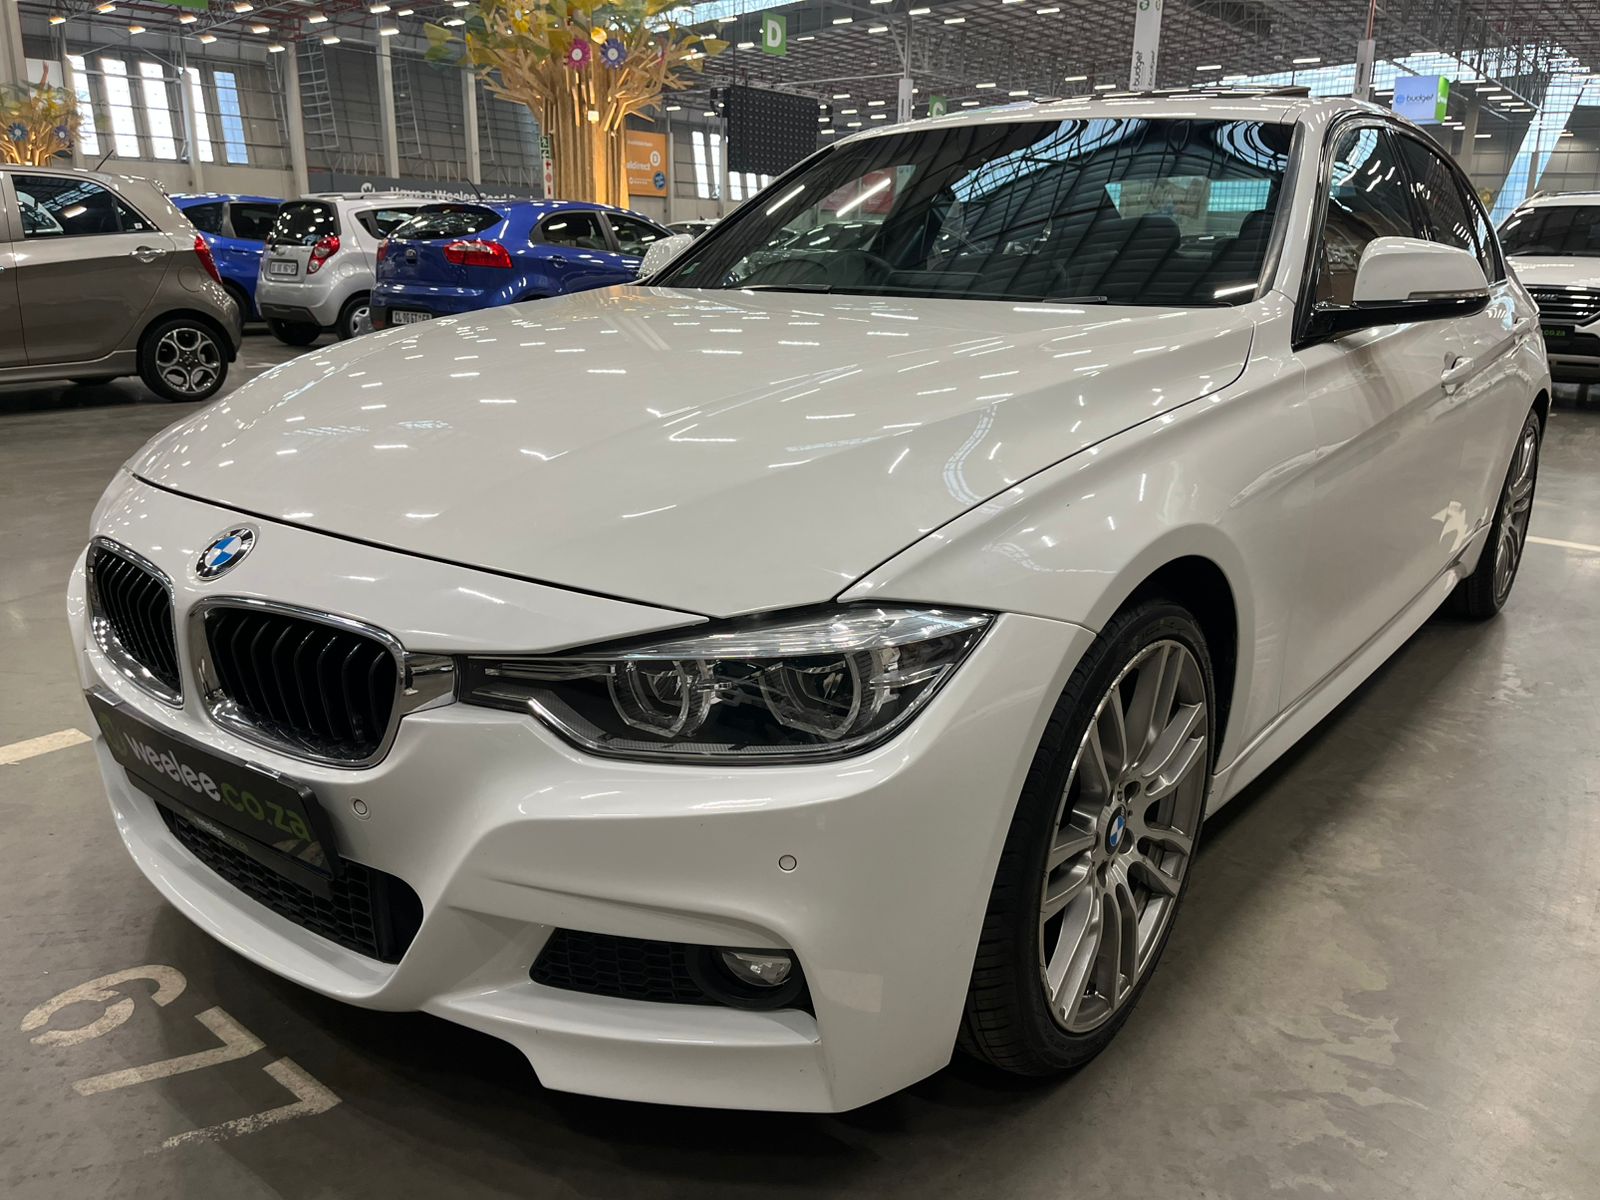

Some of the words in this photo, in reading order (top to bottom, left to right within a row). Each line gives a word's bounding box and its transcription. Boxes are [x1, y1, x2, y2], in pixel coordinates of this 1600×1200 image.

[767, 19, 782, 47] D
[1133, 50, 1144, 87] budget
[1406, 94, 1434, 103] budget
[122, 731, 312, 843] weelee.co.za
